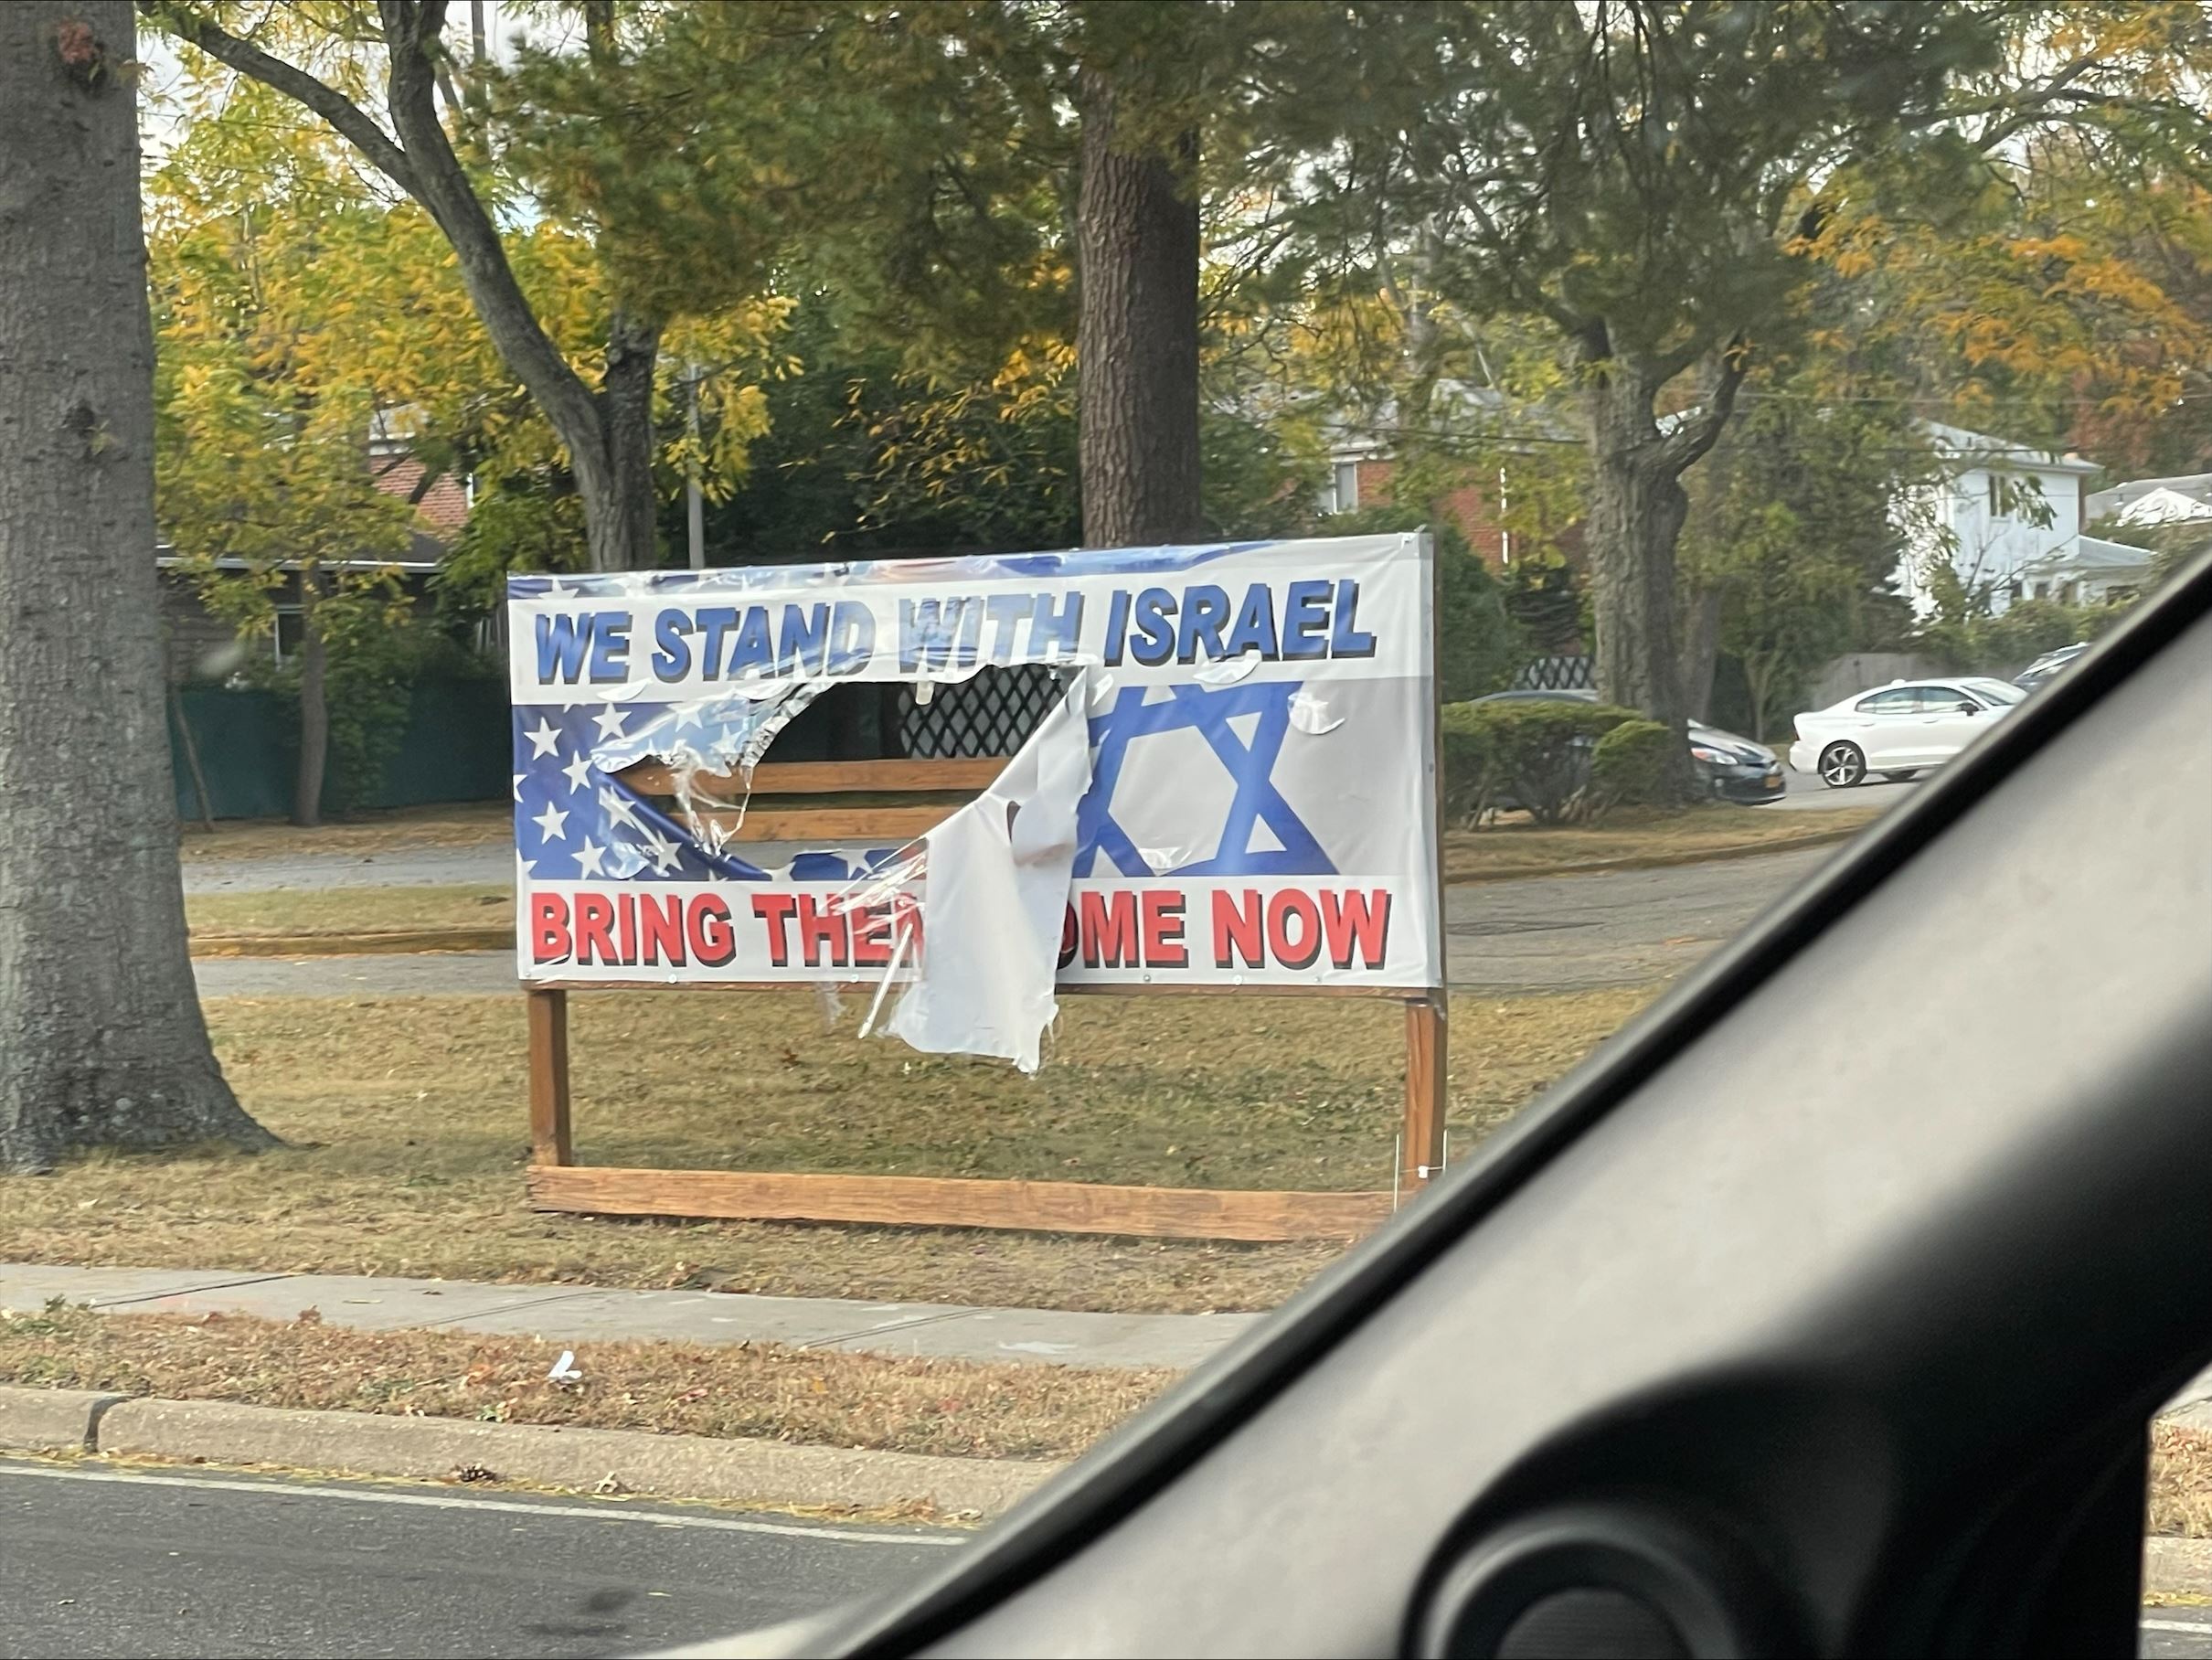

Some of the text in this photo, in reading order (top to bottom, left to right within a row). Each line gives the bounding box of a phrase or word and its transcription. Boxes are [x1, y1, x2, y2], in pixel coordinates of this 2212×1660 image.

[535, 579, 1377, 685] WE STAND WITH ISRAEL
[531, 891, 737, 968] BRING
[1058, 890, 1189, 971] ME
[1212, 889, 1393, 971] NOW
